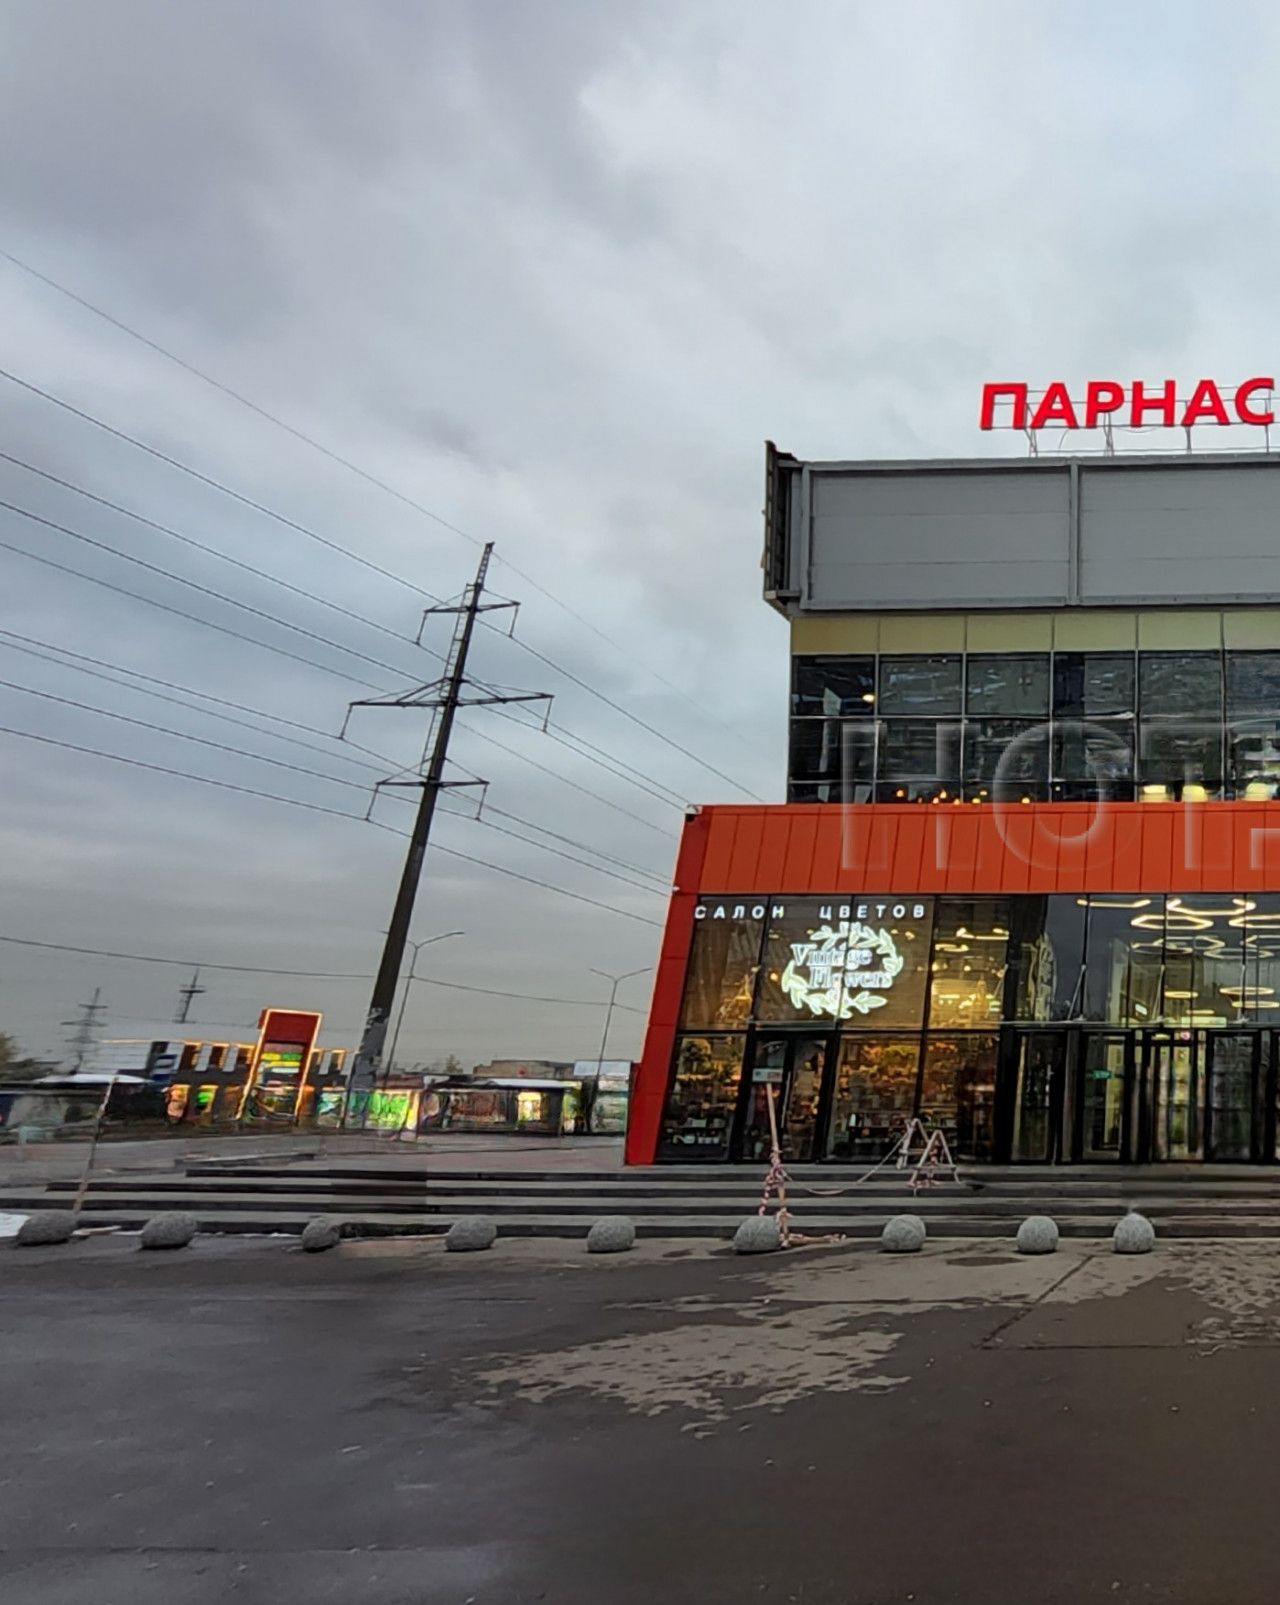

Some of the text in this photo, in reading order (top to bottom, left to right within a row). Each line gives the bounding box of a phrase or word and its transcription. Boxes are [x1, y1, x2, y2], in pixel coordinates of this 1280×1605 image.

[980, 377, 1274, 430] ПАРНАС
[694, 904, 925, 919] САЛОН ЦВЕТОВ
